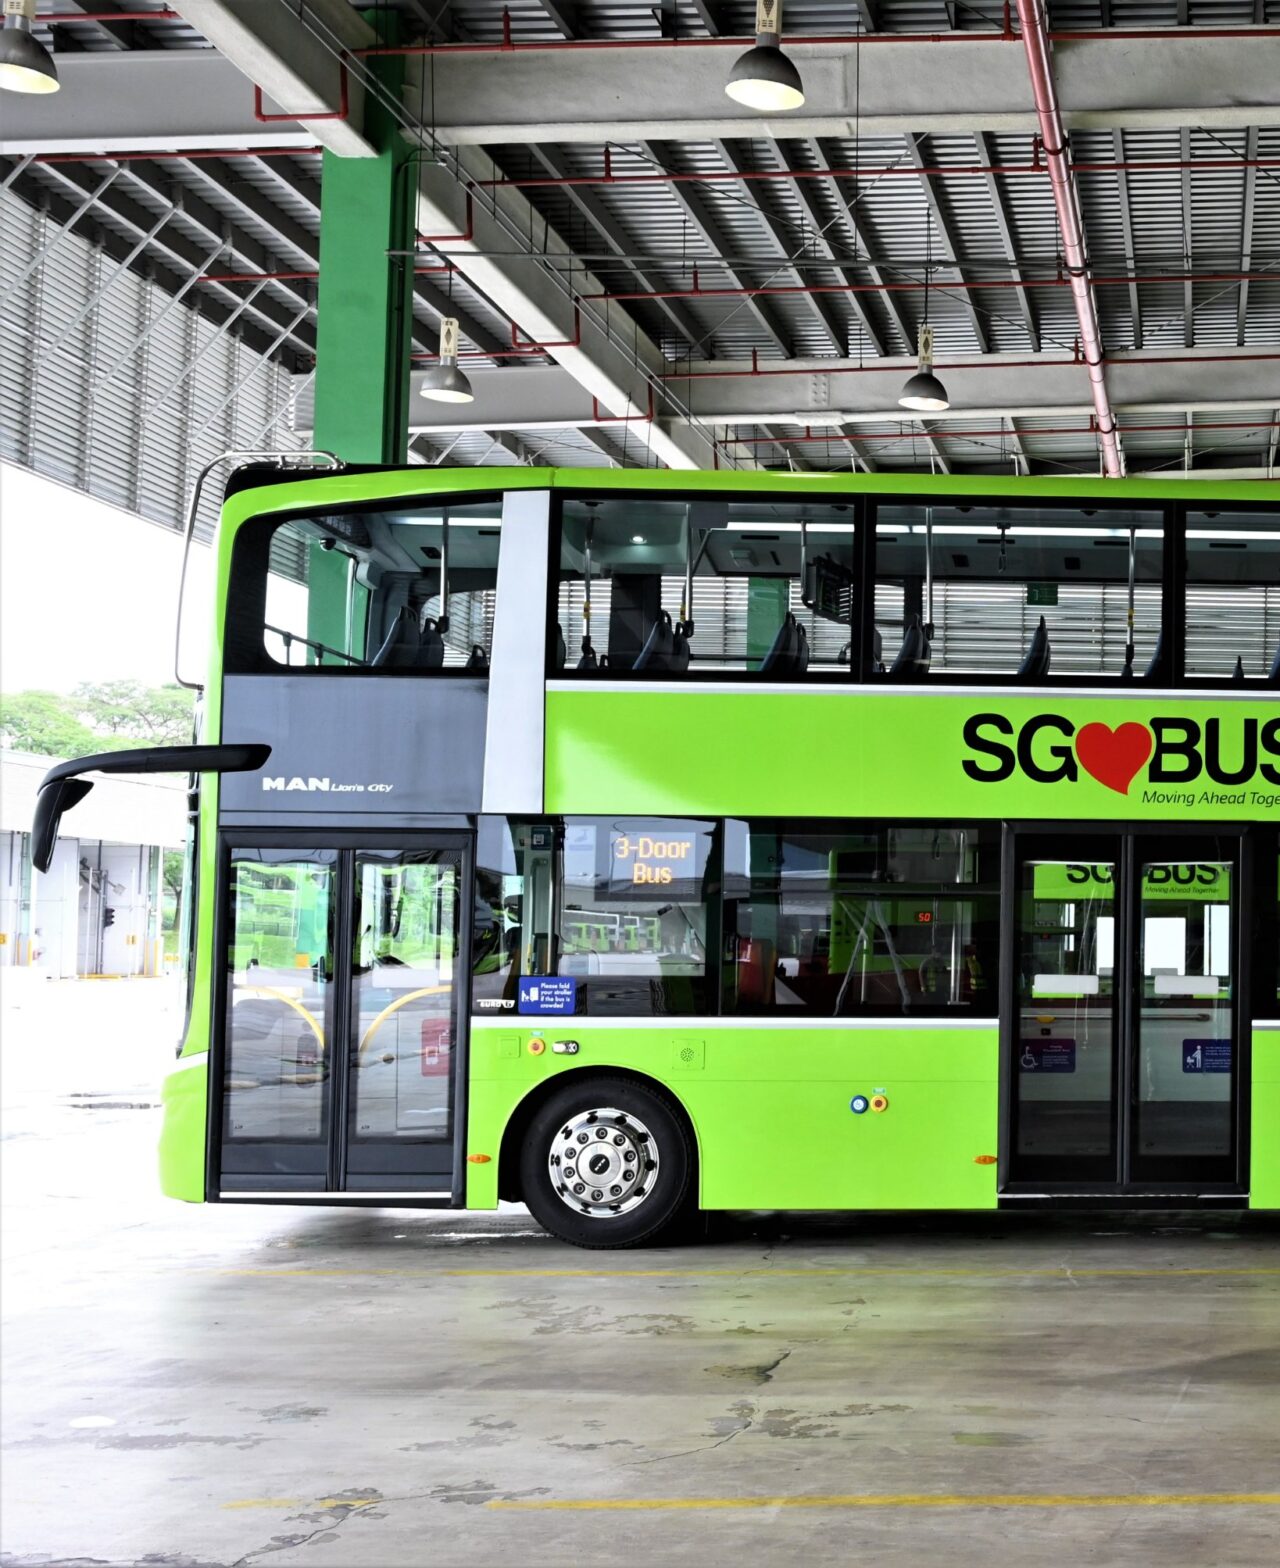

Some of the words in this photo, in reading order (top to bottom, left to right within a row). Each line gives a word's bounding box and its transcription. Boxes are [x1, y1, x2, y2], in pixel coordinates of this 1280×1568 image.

[262, 776, 330, 791] MAN
[330, 783, 364, 792] Lion's
[367, 783, 393, 793] City
[1142, 790, 1195, 806] Moving
[1198, 790, 1245, 805] Ahead
[615, 837, 691, 859] 3-Door
[633, 863, 673, 885] Bus
[1147, 863, 1219, 885] BUS
[918, 912, 931, 922] 50
[478, 1000, 502, 1008] EURO
